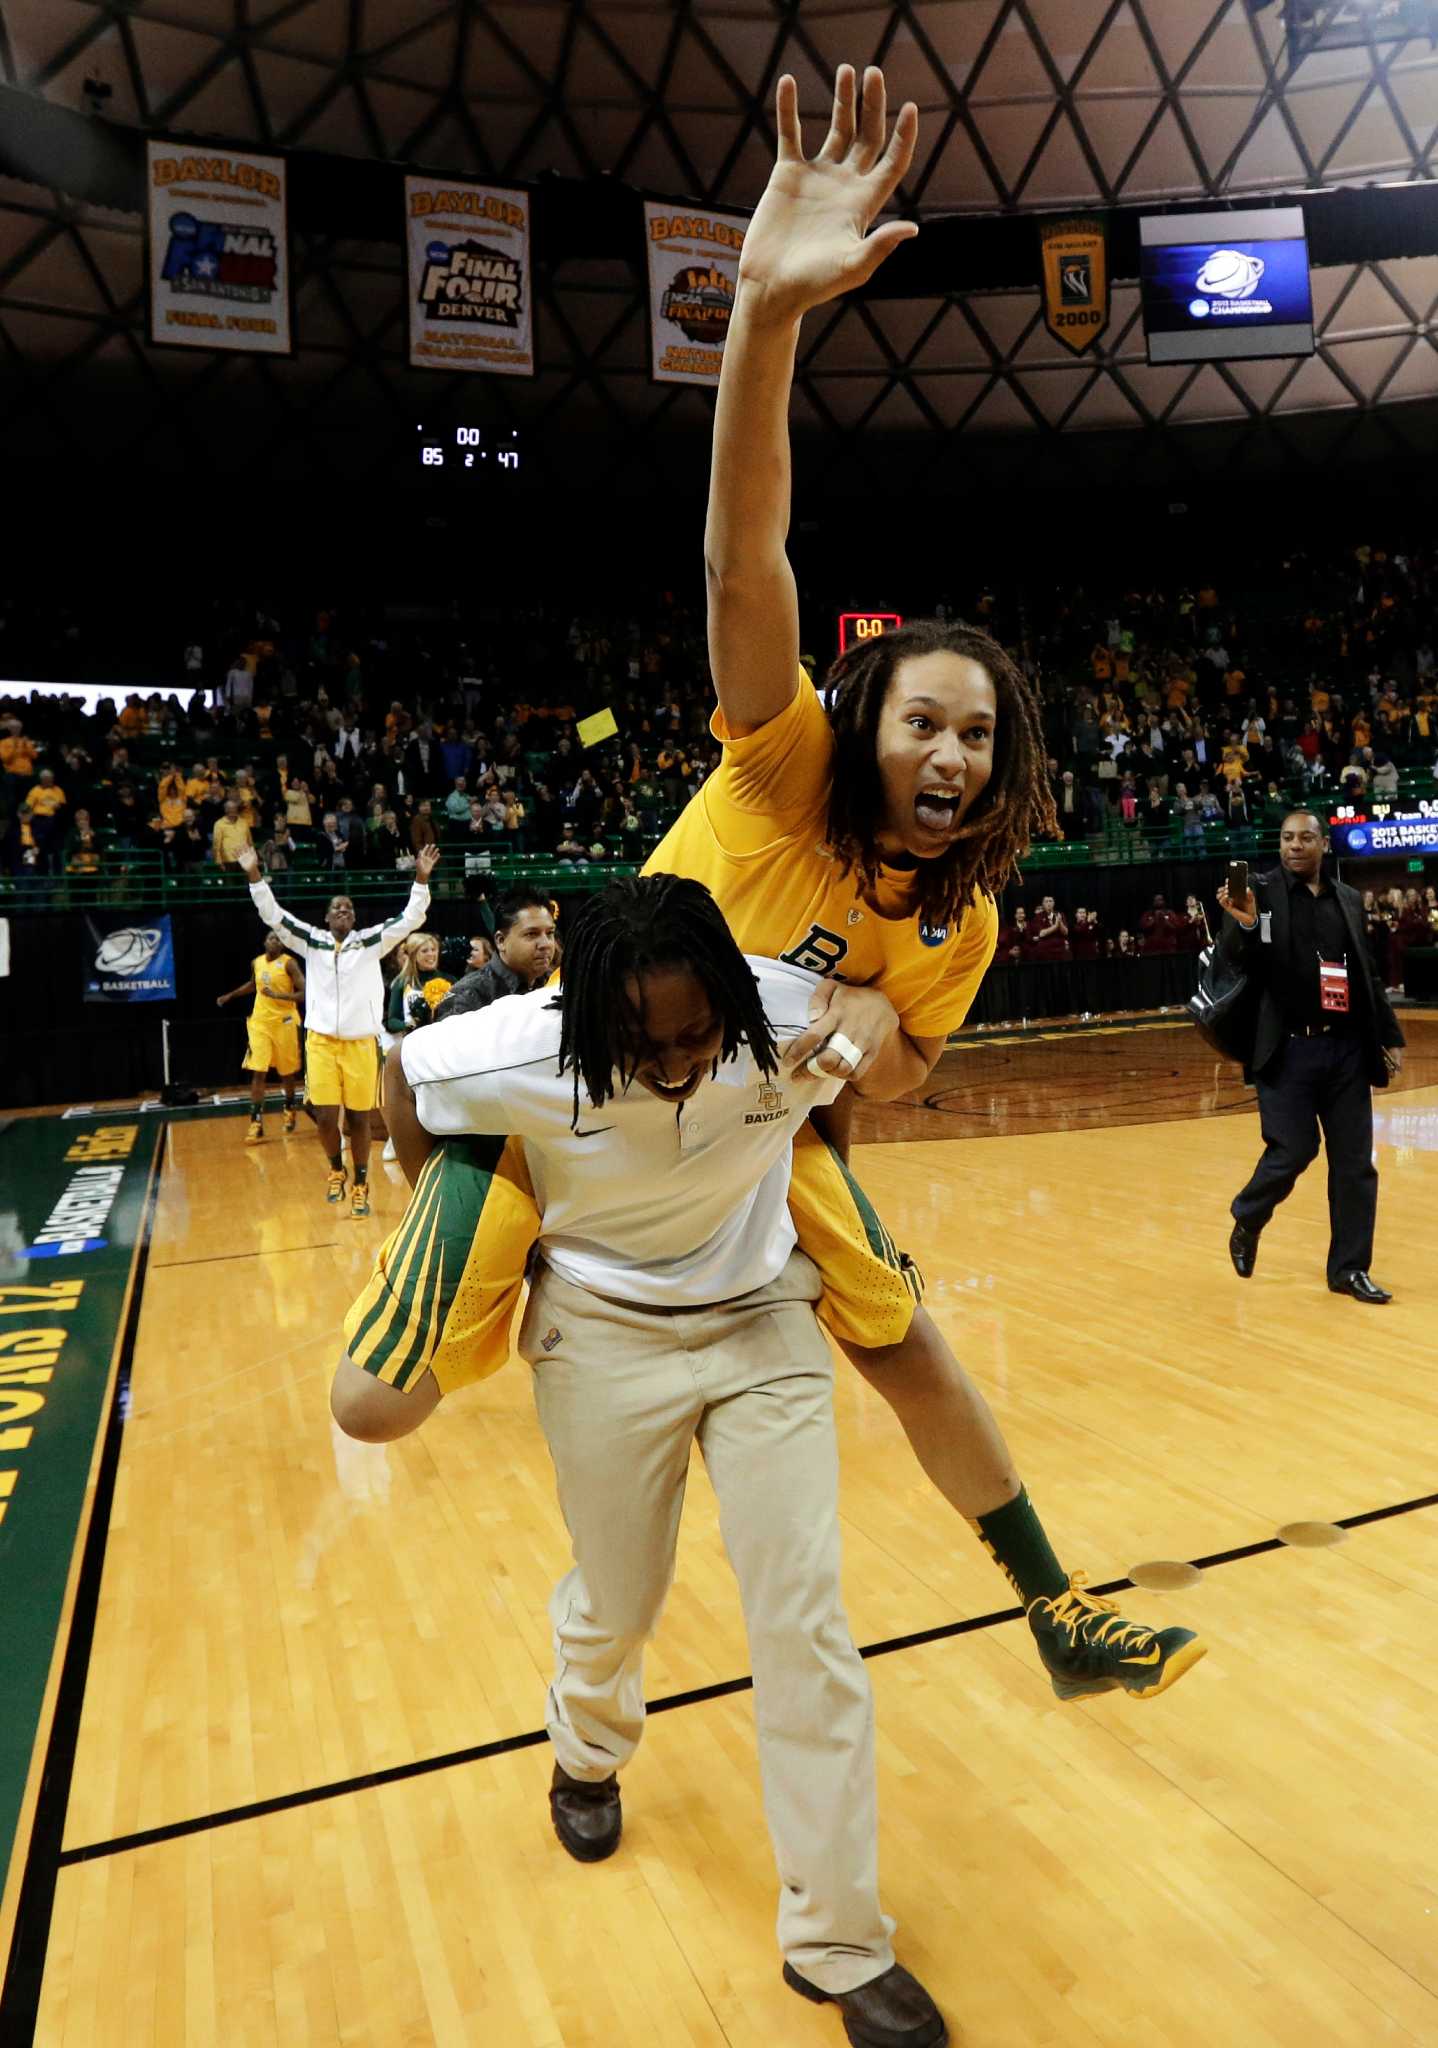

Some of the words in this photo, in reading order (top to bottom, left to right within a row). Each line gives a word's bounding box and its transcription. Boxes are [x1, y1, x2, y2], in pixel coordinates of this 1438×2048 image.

[153, 157, 280, 201] BAYLOR
[411, 191, 524, 232] BAYLOR
[451, 251, 518, 282] FINAL
[423, 265, 519, 310] FOUR
[437, 303, 510, 321] DENVER
[1056, 311, 1100, 327] 2000
[422, 447, 444, 466] 85
[464, 453, 474, 467] 2
[498, 452, 519, 469] 47
[1336, 805, 1355, 818] 85
[1371, 804, 1391, 815] BU
[1393, 811, 1422, 821] Team
[1371, 827, 1397, 838] 2013
[102, 979, 171, 991] BASKETBALL
